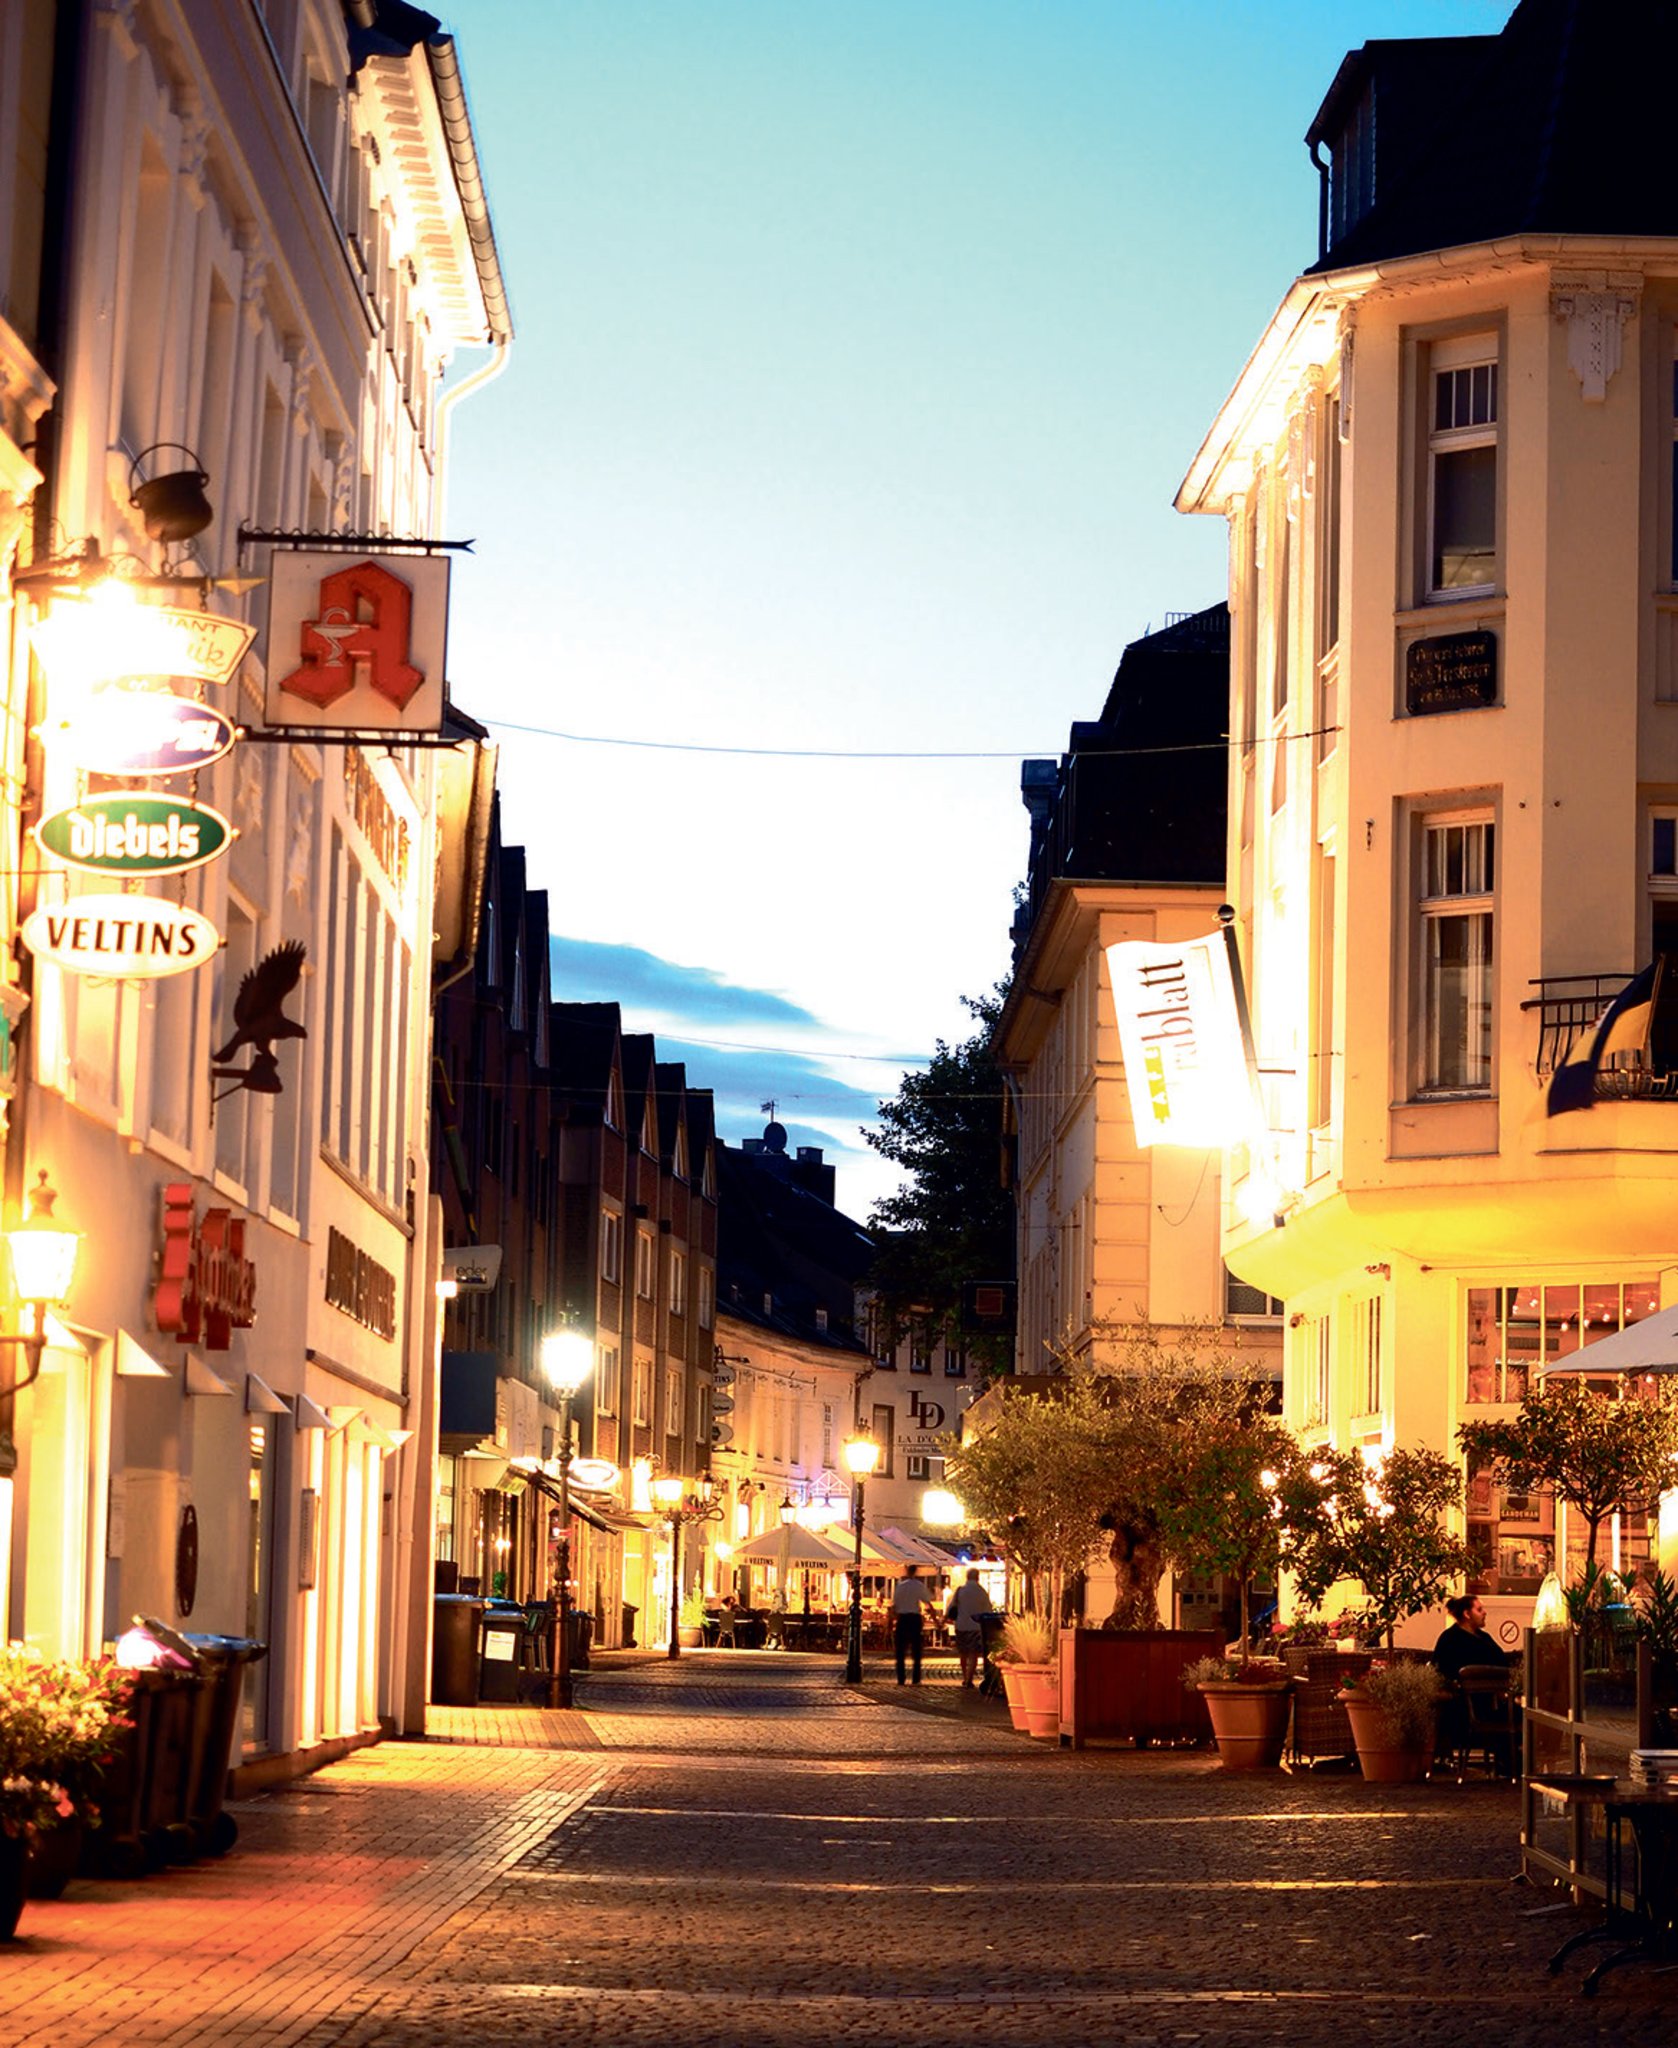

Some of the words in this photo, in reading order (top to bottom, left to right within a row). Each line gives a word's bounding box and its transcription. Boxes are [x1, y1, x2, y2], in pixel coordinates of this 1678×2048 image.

[66, 811, 200, 858] Diebels
[47, 916, 197, 956] VELTINS
[749, 1557, 774, 1565] VELTINS
[801, 1560, 828, 1569] VELTINS
